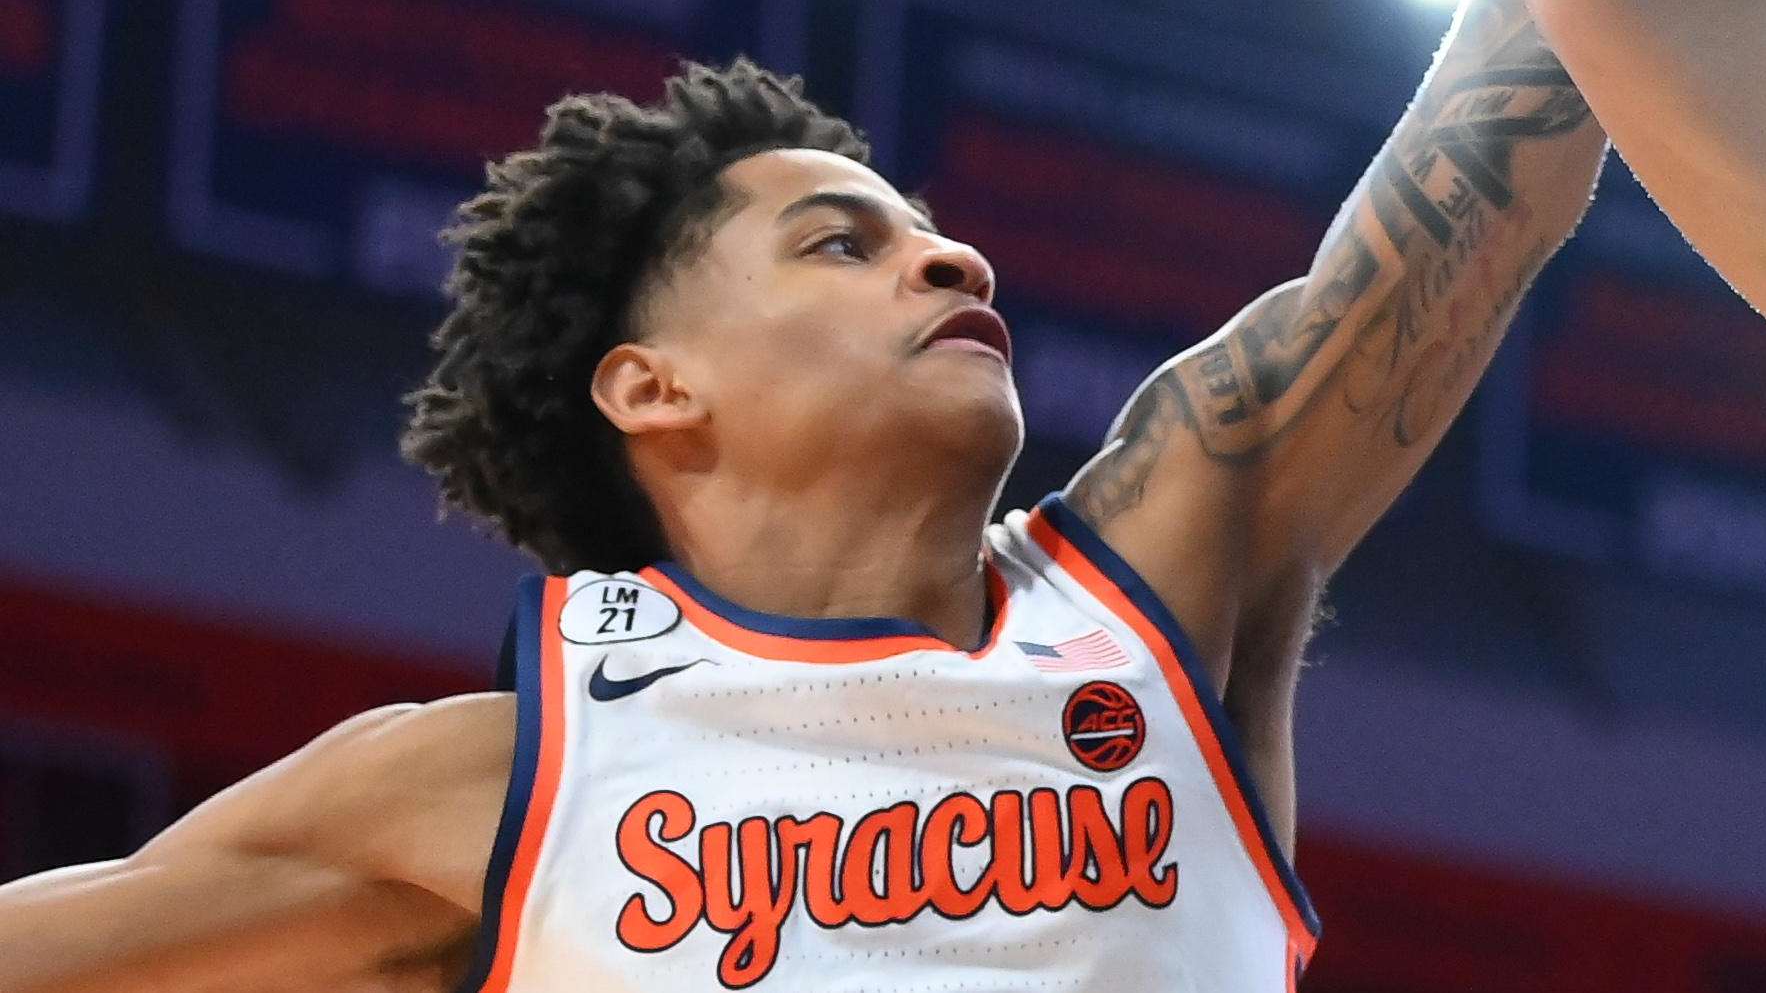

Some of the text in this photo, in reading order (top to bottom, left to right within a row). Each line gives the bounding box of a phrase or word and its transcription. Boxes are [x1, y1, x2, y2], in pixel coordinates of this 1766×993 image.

[601, 585, 640, 605] LM
[596, 606, 637, 635] 21
[616, 775, 1179, 991] Syracuse
